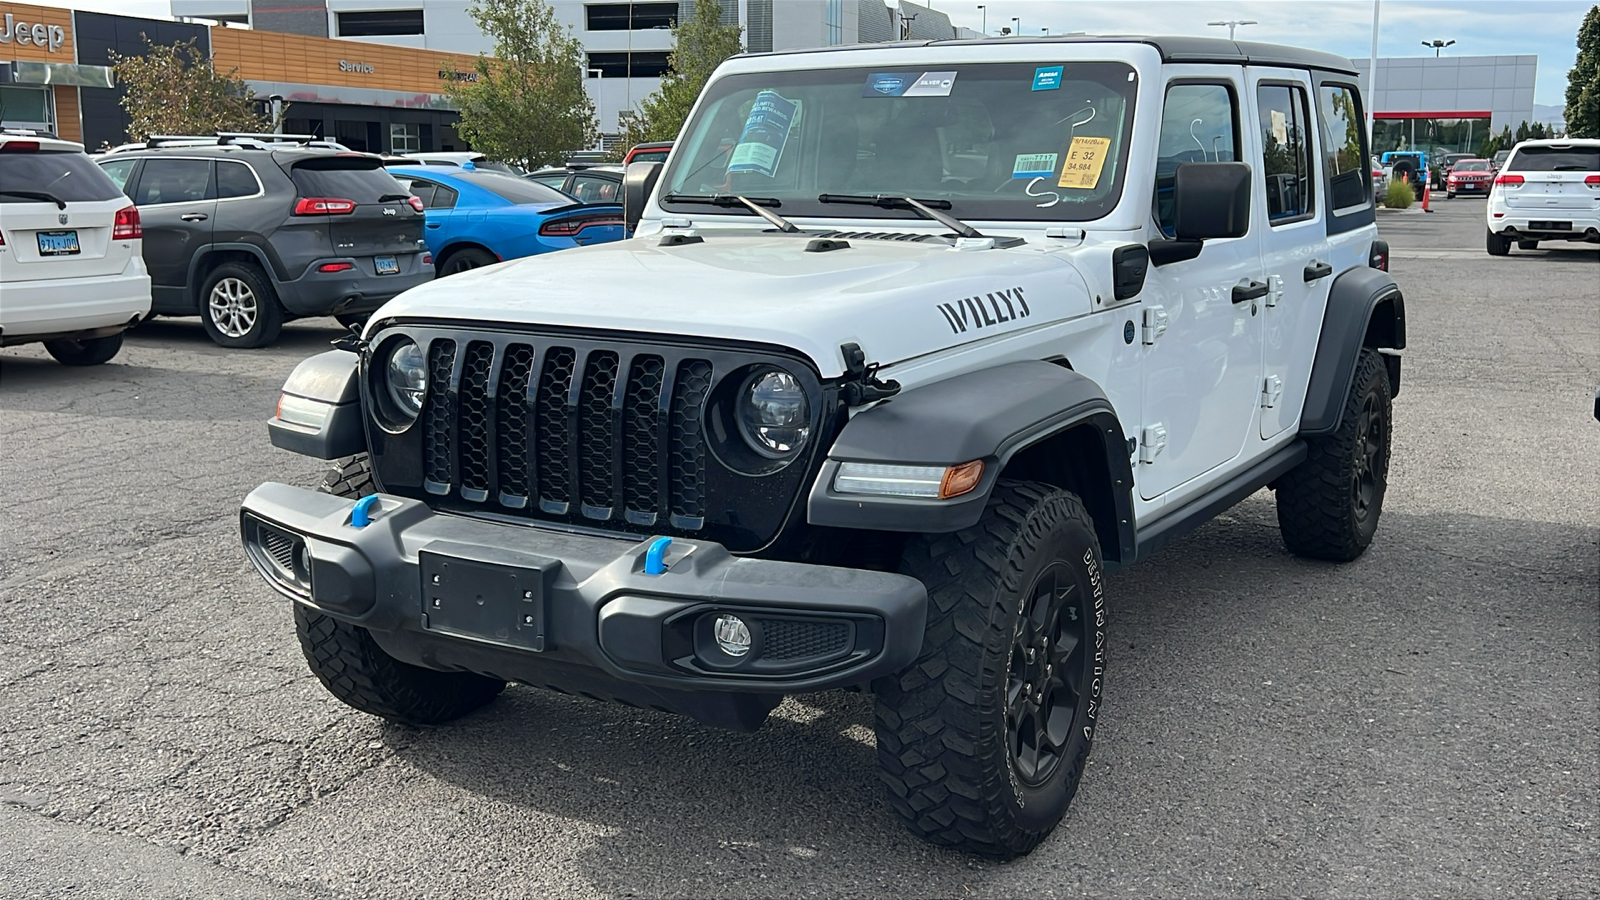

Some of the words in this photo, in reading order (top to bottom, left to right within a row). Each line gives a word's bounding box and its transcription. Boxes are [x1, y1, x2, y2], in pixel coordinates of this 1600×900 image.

[0, 13, 65, 53] Jeep
[339, 59, 374, 74] Service
[1071, 151, 1078, 160] E
[1082, 151, 1095, 161] 32
[936, 286, 1030, 334] WILLYS
[1083, 547, 1105, 720] DESTINATION
